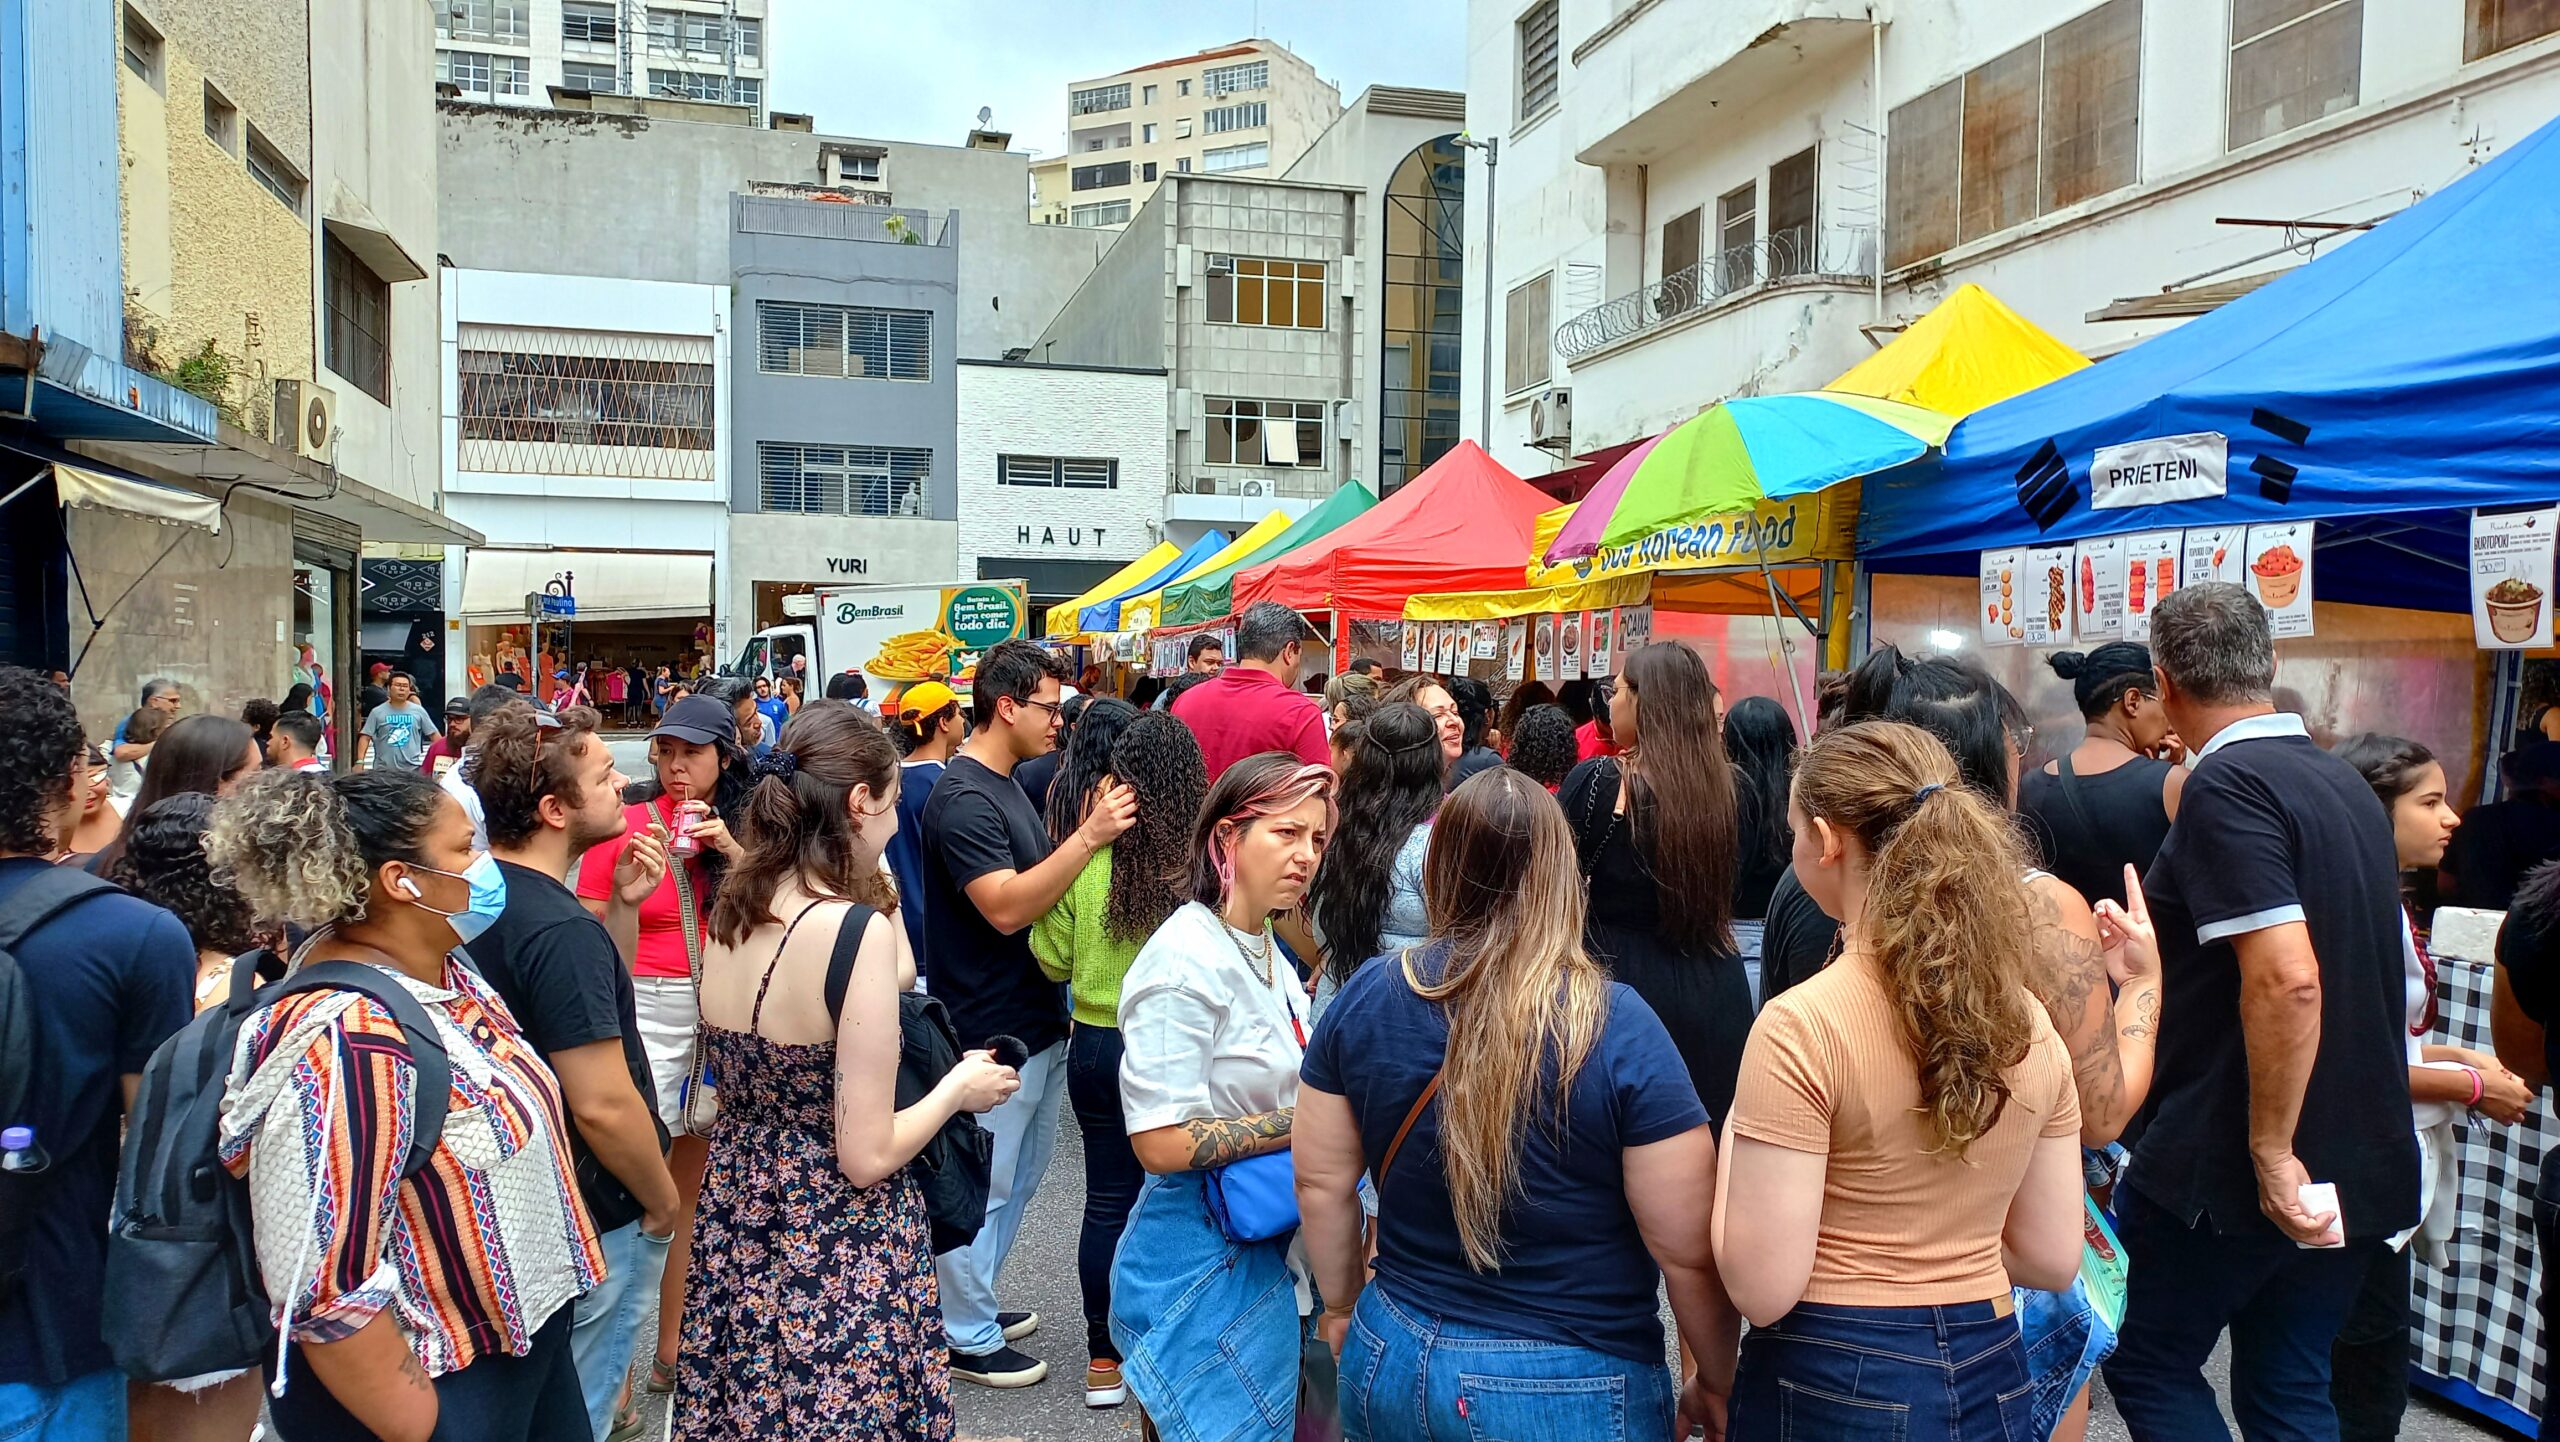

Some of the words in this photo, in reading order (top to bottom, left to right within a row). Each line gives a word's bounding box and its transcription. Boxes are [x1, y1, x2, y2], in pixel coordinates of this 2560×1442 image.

[2108, 458, 2198, 488] PRIETENI
[1018, 525, 1106, 546] HAUT
[1726, 504, 1797, 555] Food
[826, 557, 867, 574] YURI
[836, 602, 904, 625] BemBrasil
[954, 603, 975, 612] Bem
[976, 601, 1009, 611] Brasil.
[954, 620, 984, 631] todo
[985, 619, 1010, 630] dia.
[961, 613, 979, 622] pra
[980, 611, 1009, 620] comer
[1626, 612, 1650, 638] CAIXA
[421, 631, 436, 639] 212
[386, 713, 414, 724] PUMA
